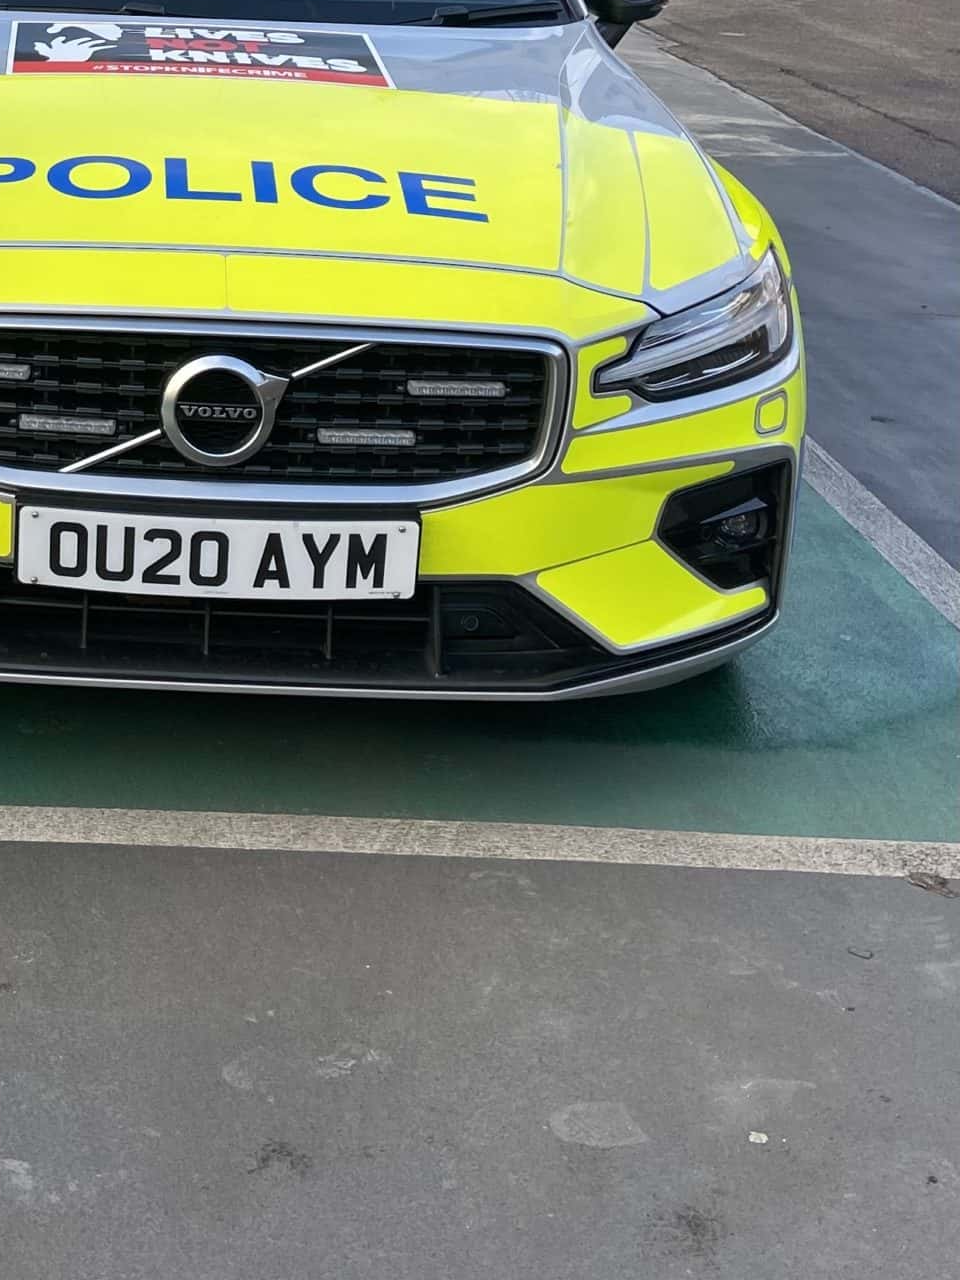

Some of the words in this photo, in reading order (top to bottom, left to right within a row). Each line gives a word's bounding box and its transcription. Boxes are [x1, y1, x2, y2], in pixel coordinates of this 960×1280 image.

[144, 26, 305, 45] LIVES
[146, 37, 265, 53] NOT
[149, 48, 368, 73] KNIVES
[92, 62, 309, 79] #STOPKNIFECRIME
[179, 404, 258, 420] VOLVO
[48, 520, 230, 587] OU20
[253, 532, 388, 589] AYM
